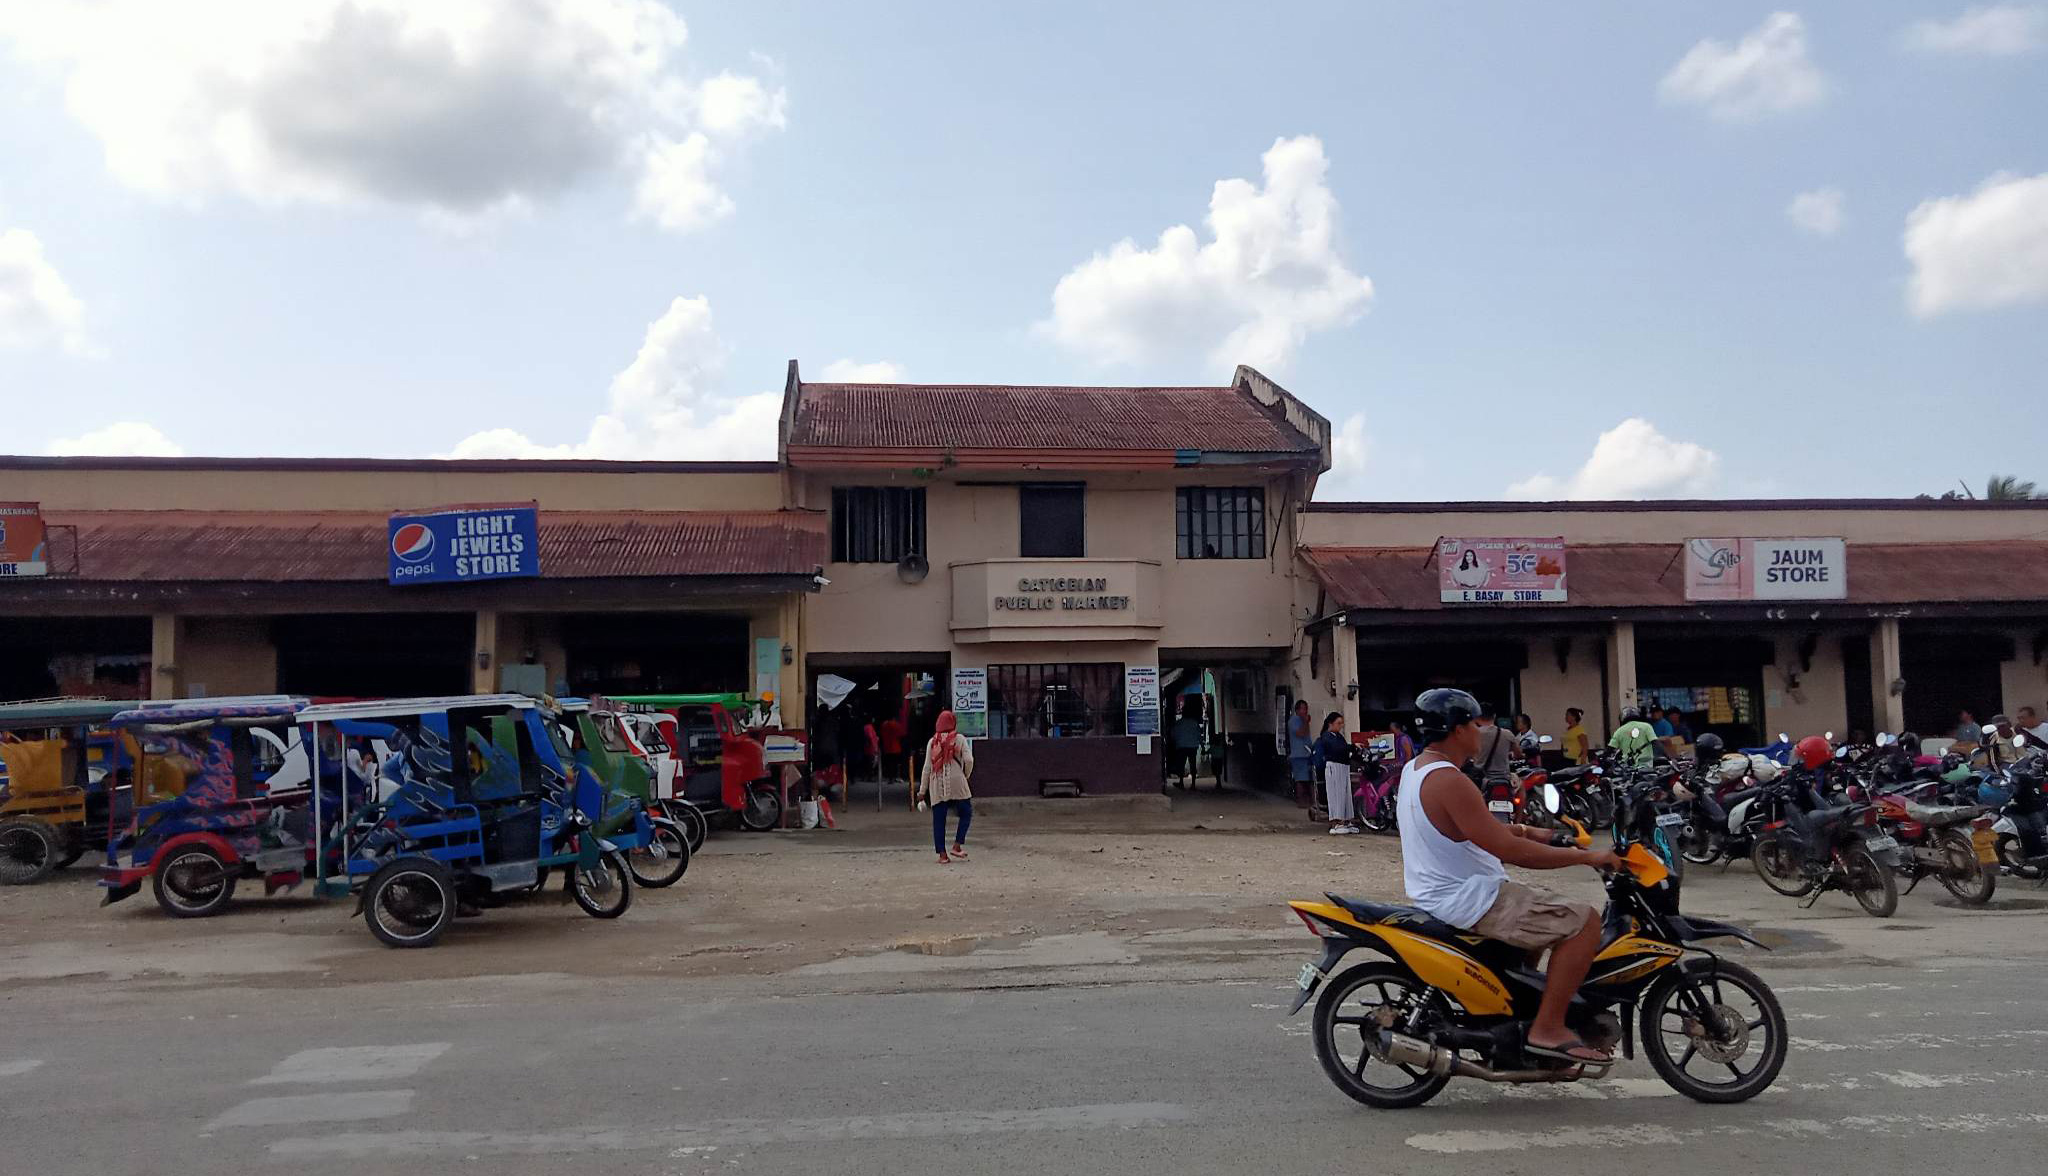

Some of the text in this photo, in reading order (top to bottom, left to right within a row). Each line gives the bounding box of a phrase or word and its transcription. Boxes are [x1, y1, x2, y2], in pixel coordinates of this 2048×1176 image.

[456, 515, 516, 537] EIGHT
[450, 534, 525, 557] JEWELS
[456, 554, 521, 576] STORE
[1771, 550, 1824, 565] JAUM
[0, 563, 18, 575] RE
[395, 562, 435, 579] pepsi
[1766, 567, 1829, 583] STORE
[1018, 578, 1107, 592] CATIGBIAN
[1463, 590, 1543, 601] E. BASAY STORE
[995, 596, 1130, 611] PUBLIC MARKET
